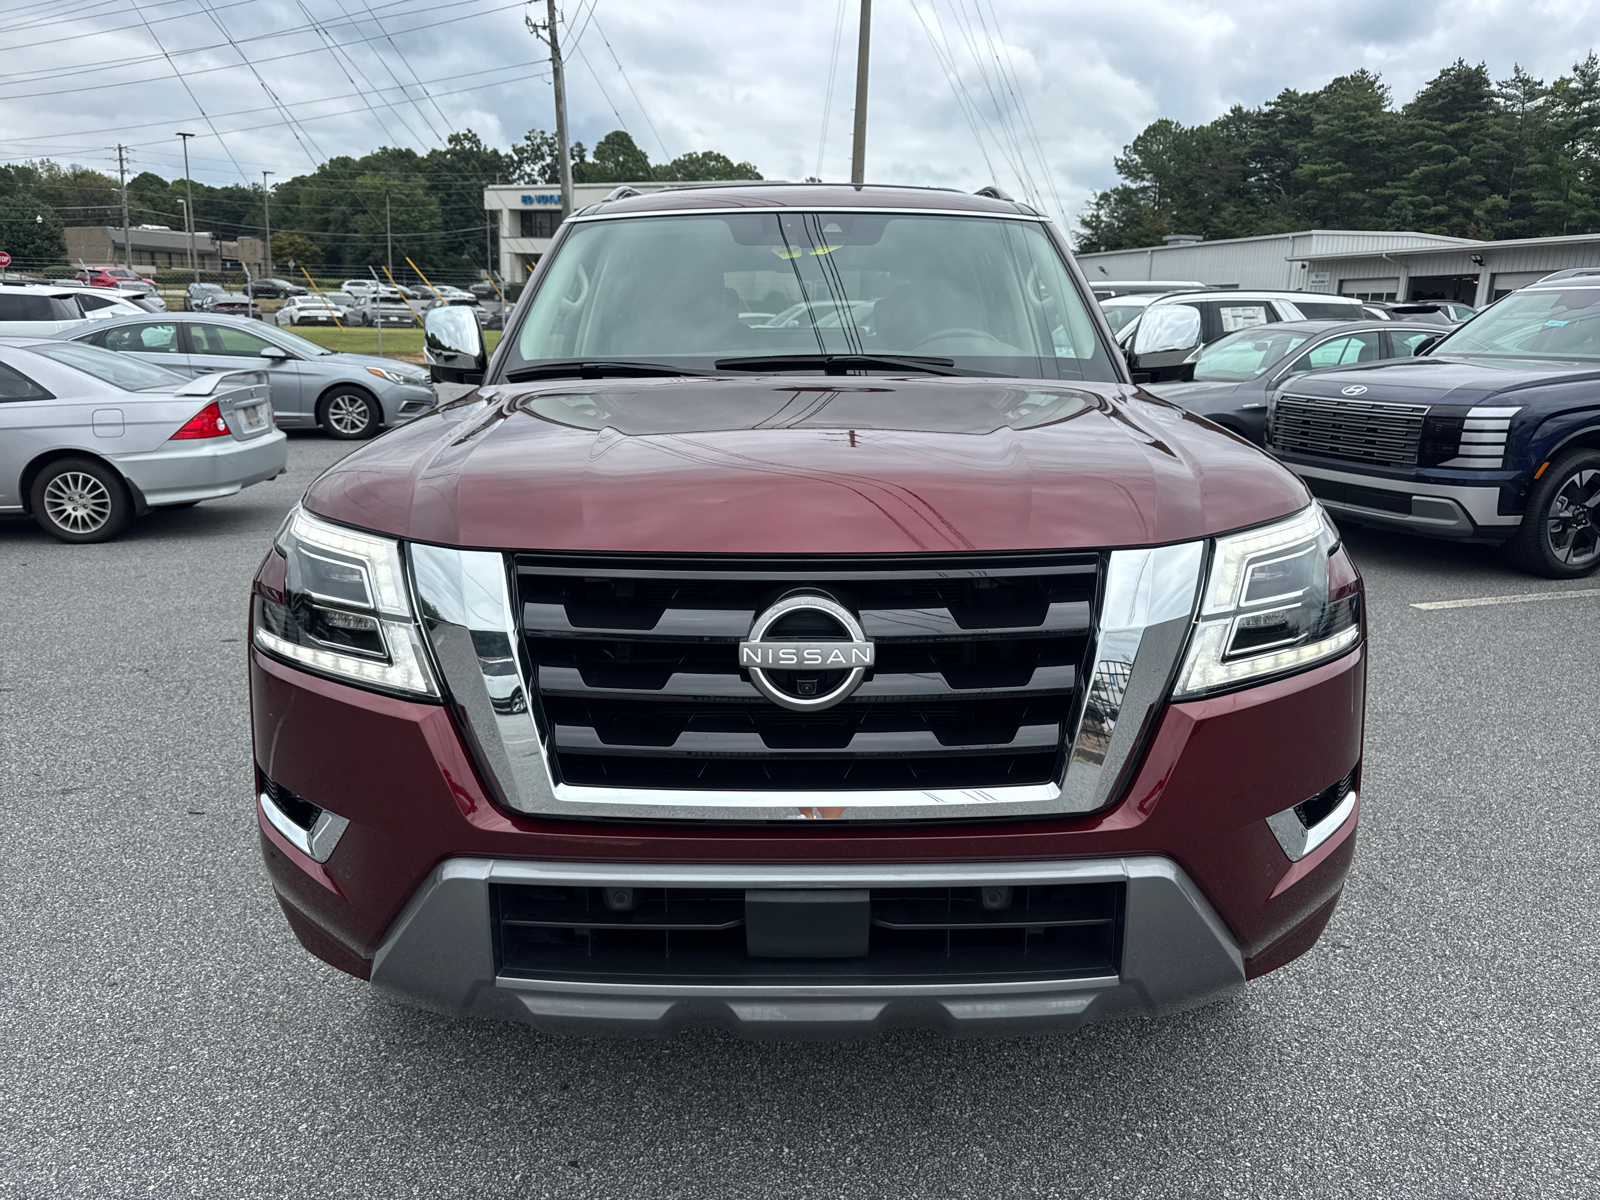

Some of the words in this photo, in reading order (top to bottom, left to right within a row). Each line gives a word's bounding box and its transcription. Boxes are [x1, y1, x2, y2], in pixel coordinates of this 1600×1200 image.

[521, 194, 534, 204] ED
[535, 194, 562, 204] VOYLE
[743, 647, 870, 664] NISSAN
